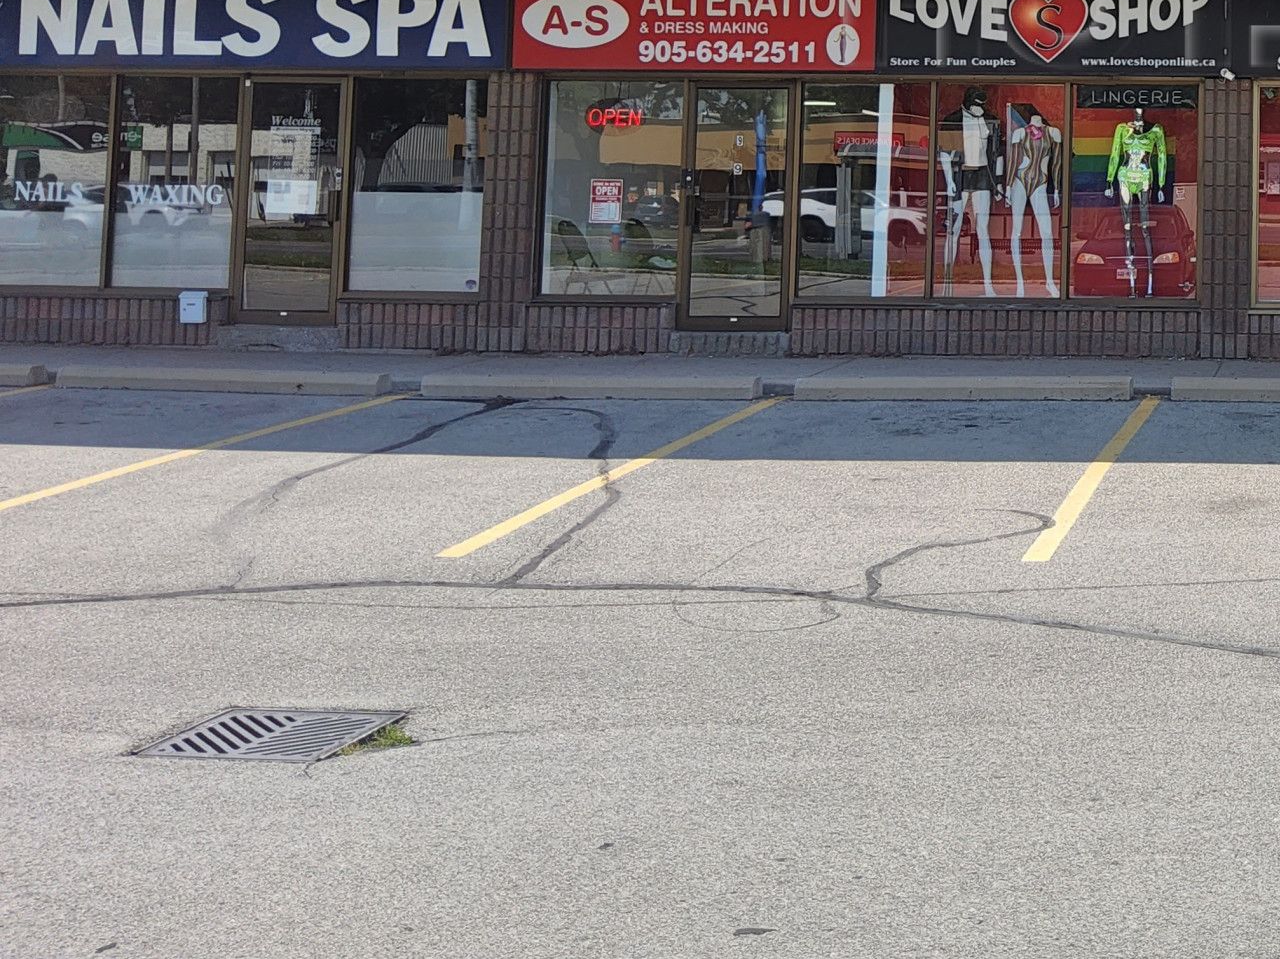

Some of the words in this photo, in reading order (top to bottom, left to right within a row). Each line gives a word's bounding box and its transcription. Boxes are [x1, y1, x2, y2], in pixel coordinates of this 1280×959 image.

[542, 5, 610, 36] A-S
[640, 23, 649, 34] &
[654, 22, 705, 34] DRESS
[709, 22, 769, 34] MAKING
[1034, 4, 1064, 50] S
[639, 40, 816, 63] 905-634-2511
[890, 57, 921, 67] Store
[924, 57, 942, 67] For
[946, 57, 967, 67] Fun
[971, 57, 1016, 68] Couples
[1081, 57, 1216, 68] www.loveshoponline.ca
[1092, 90, 1183, 105] LINGERIE
[272, 115, 322, 126] Welcome
[588, 109, 642, 127] OPEN
[14, 181, 83, 202] NAILS
[128, 185, 224, 205] WAXING
[595, 186, 619, 196] OPEN
